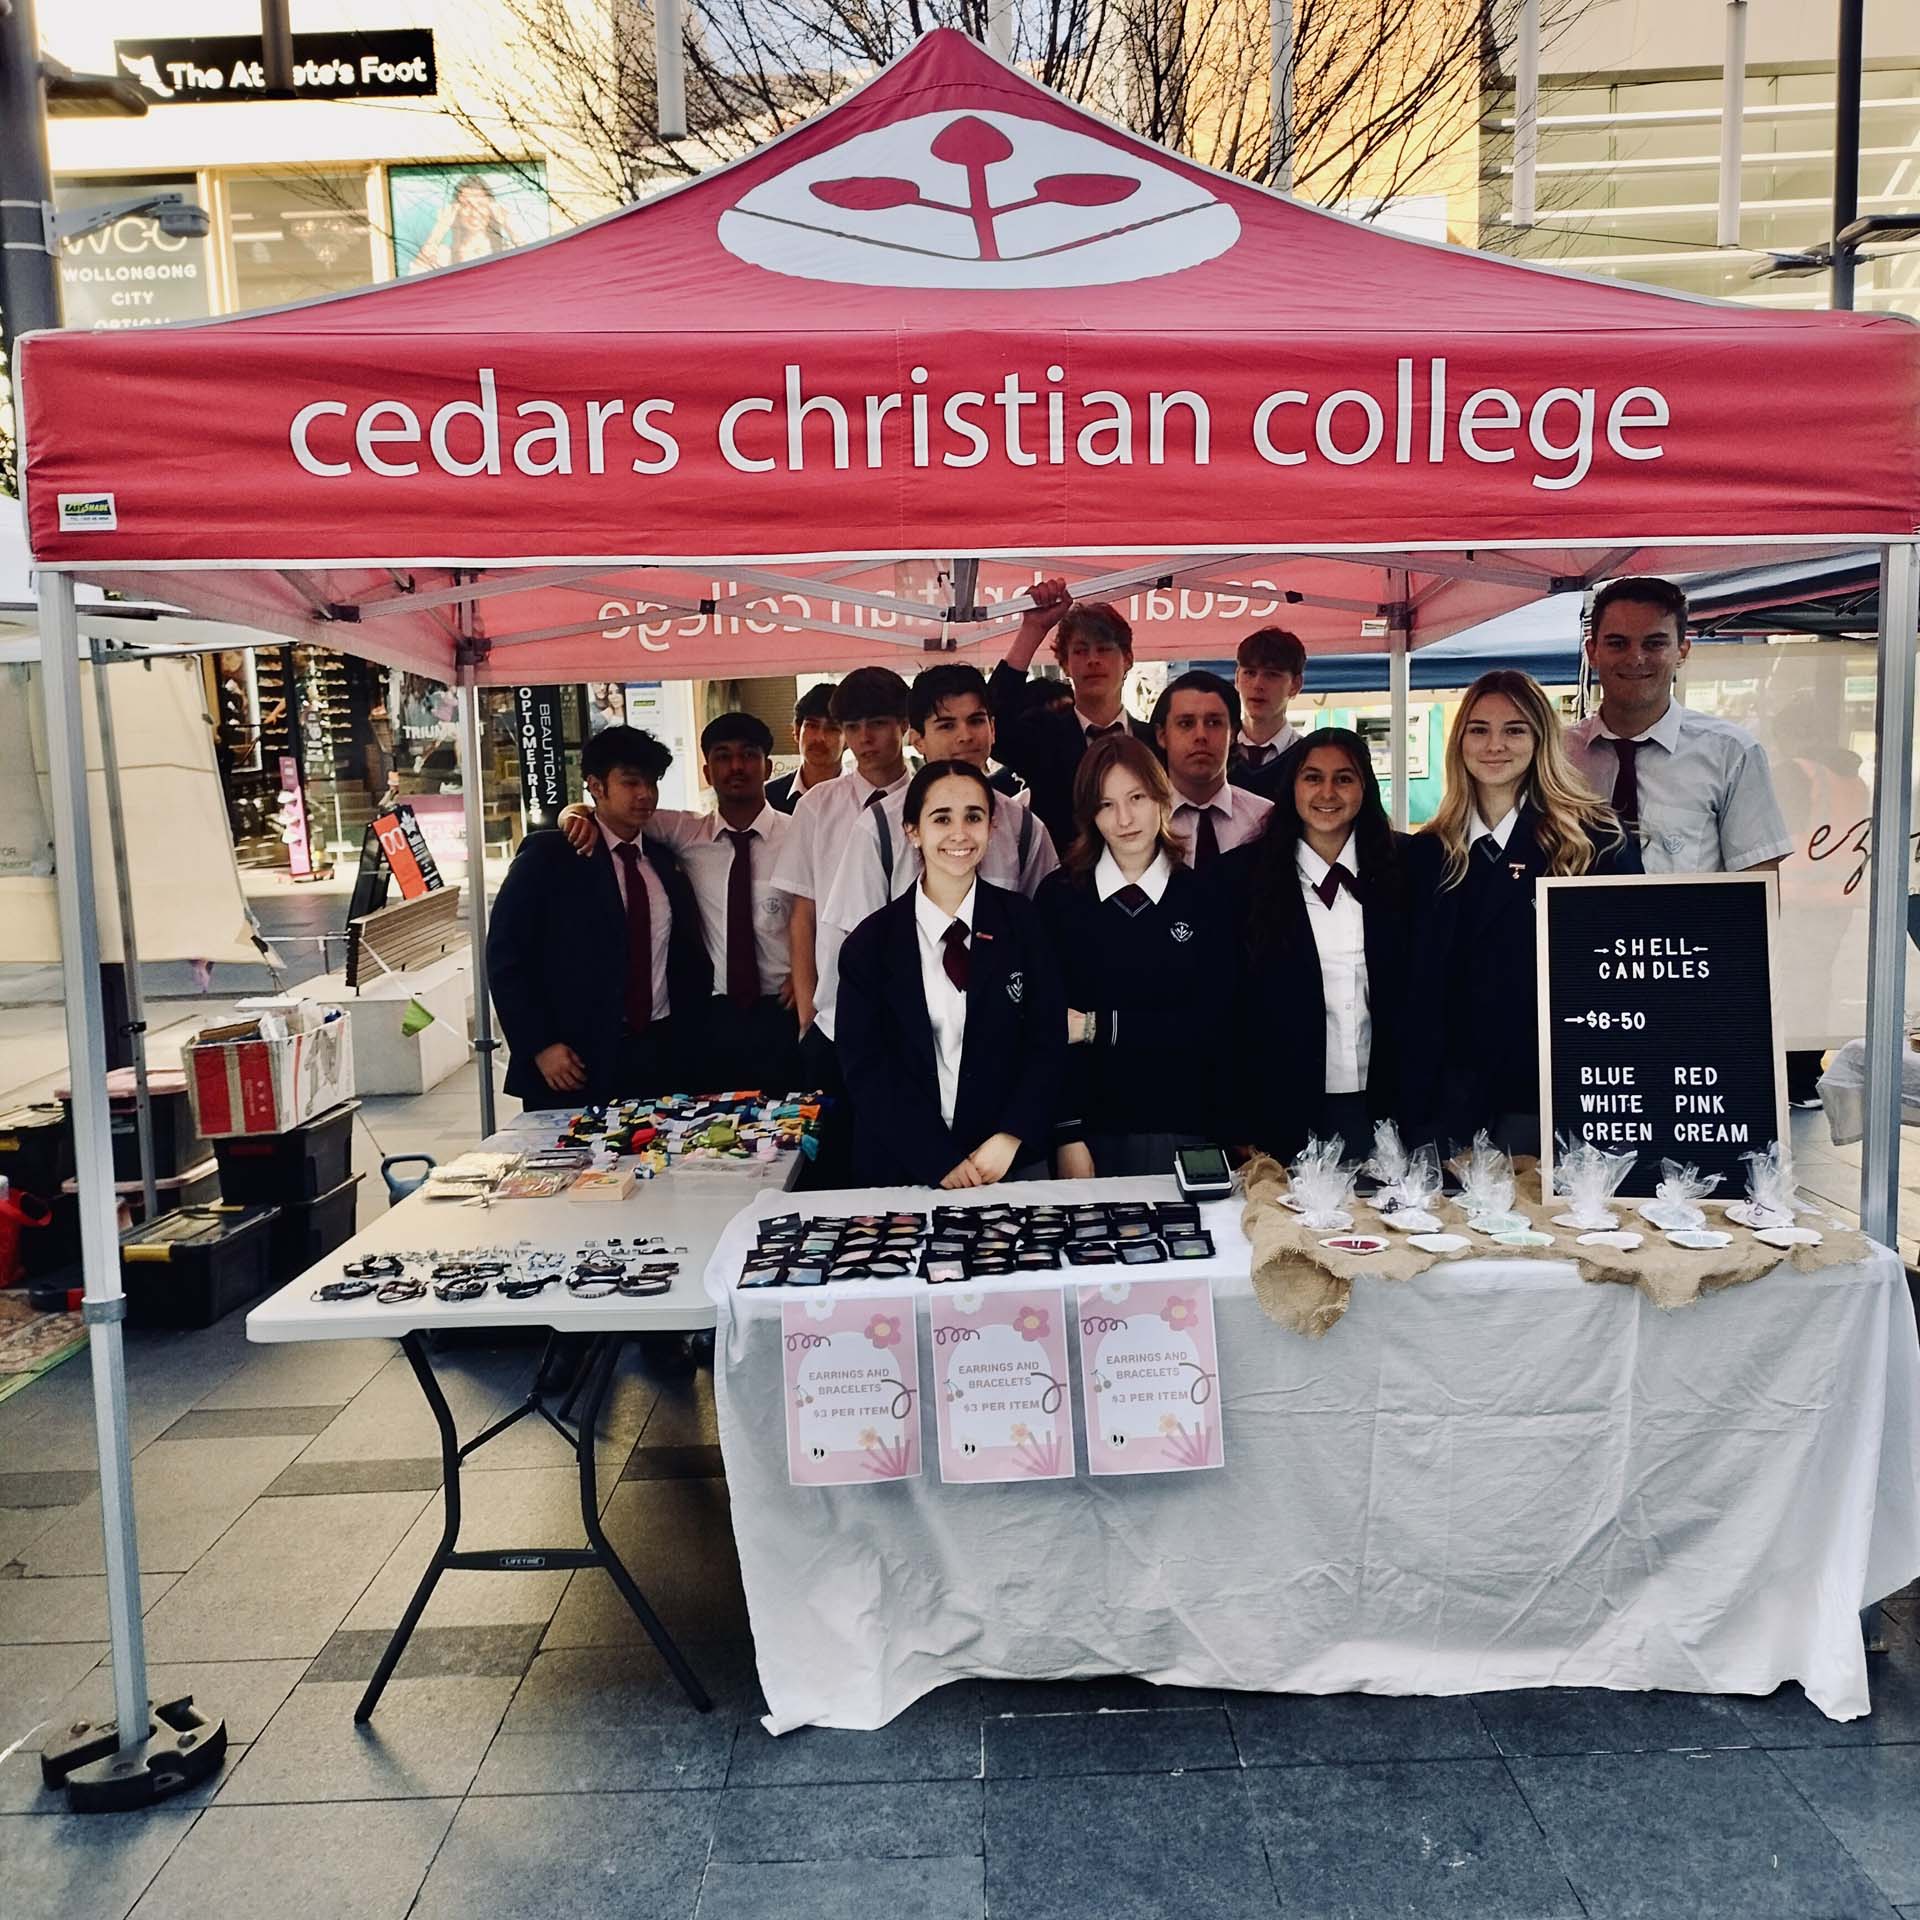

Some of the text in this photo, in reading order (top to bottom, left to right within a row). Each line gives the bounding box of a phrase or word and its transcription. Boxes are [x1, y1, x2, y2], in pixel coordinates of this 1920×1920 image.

[166, 62, 224, 91] The
[360, 56, 428, 84] Foot
[63, 264, 197, 282] WOLLONGONG
[111, 291, 154, 306] CITY
[289, 357, 1670, 491] cedars christian college
[539, 703, 558, 805] BEAUTICIAN
[1614, 938, 1692, 956] SHELL
[1598, 961, 1710, 979] CANDLES
[1586, 1010, 1646, 1030] $6-50
[1580, 1067, 1635, 1085] BLUE
[1674, 1067, 1718, 1085] RED
[1580, 1094, 1643, 1113] WHITE
[1675, 1095, 1725, 1114] PINK
[1582, 1122, 1652, 1142] GREEN
[1674, 1123, 1748, 1143] CREAM
[1106, 1351, 1188, 1365] EARRINGS AND
[808, 1368, 890, 1381] EARRINGS AND
[958, 1361, 1040, 1374] EARRINGS AND
[1116, 1367, 1180, 1380] BRACELETS
[818, 1383, 882, 1395] BRACELETS
[968, 1376, 1032, 1389] BRACELETS
[981, 1402, 1006, 1411] PER
[1009, 1400, 1040, 1410] ITEM
[1130, 1392, 1154, 1402] PER
[1158, 1391, 1188, 1401] ITEM
[831, 1408, 855, 1417] PER
[860, 1406, 889, 1416] ITEM
